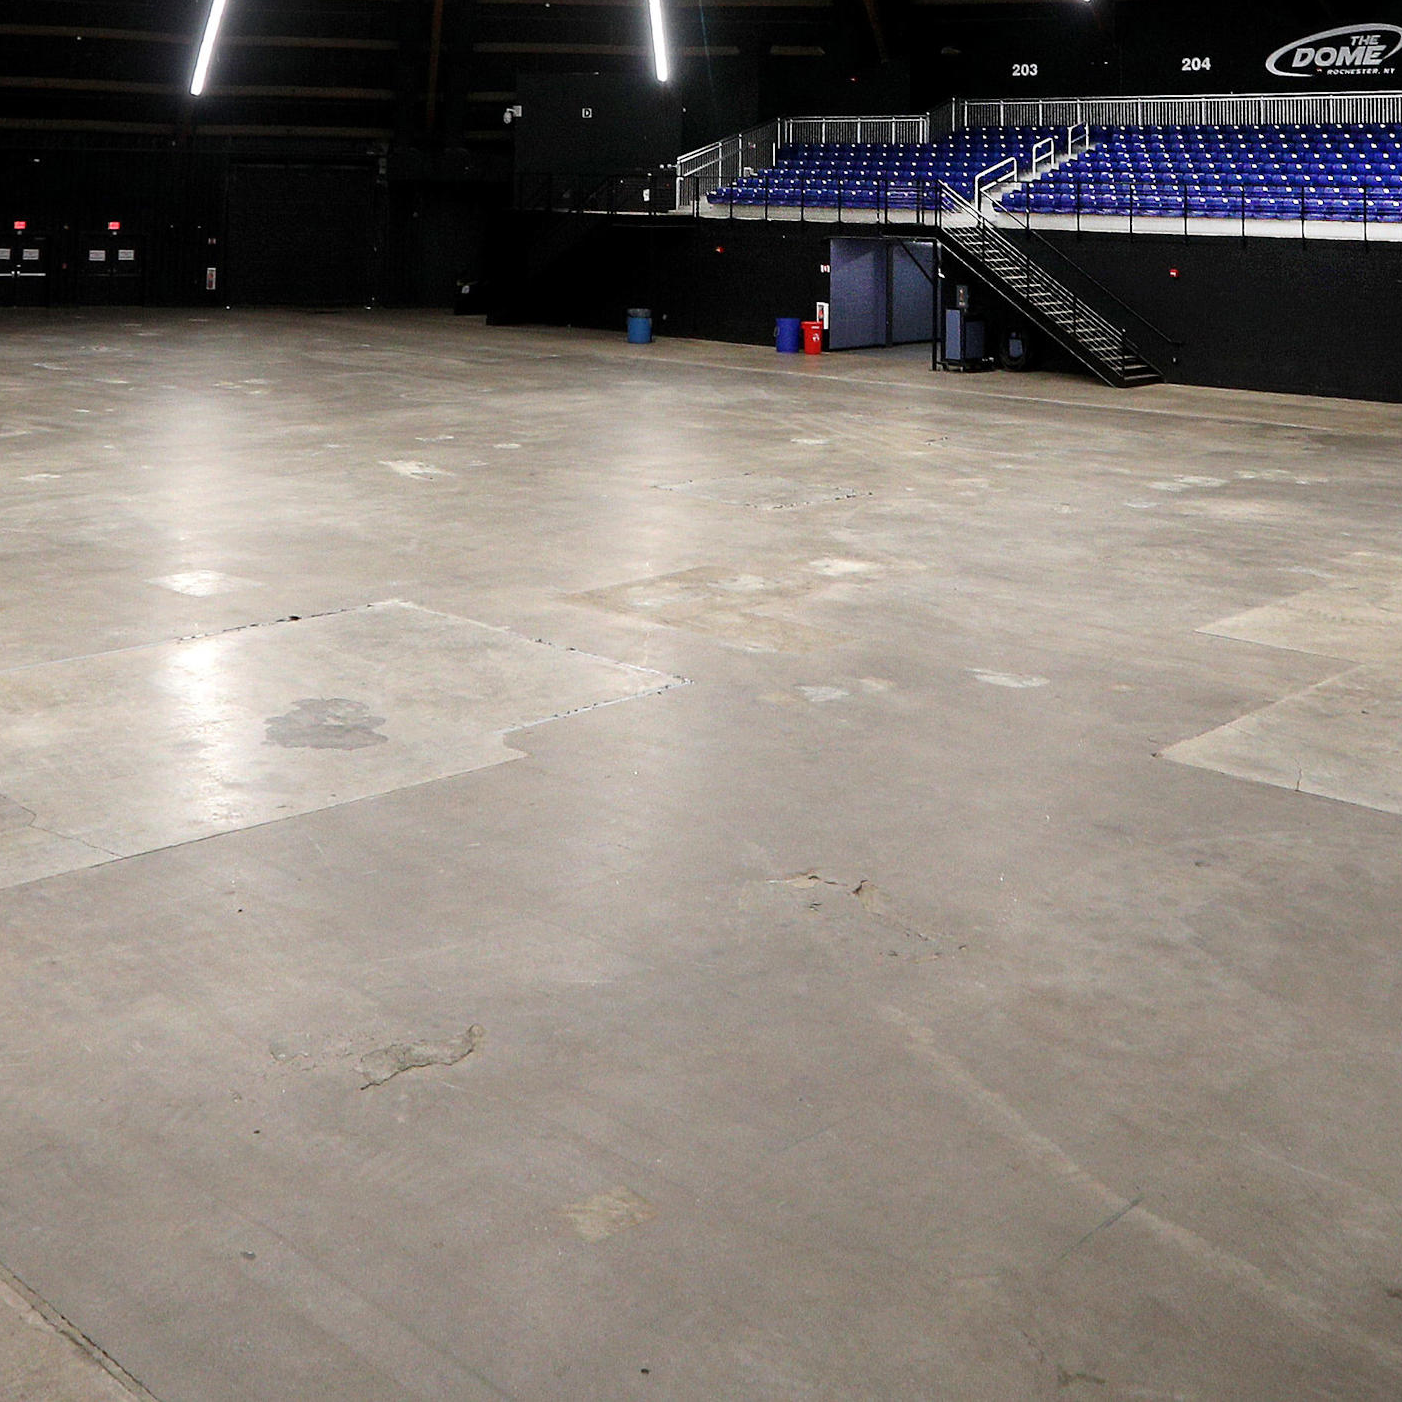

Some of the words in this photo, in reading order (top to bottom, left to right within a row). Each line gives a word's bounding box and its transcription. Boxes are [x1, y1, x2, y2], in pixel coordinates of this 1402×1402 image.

[1350, 34, 1381, 46] THE
[1291, 44, 1387, 68] DOME
[1011, 63, 1039, 77] 203
[1181, 56, 1212, 71] 204
[1383, 67, 1396, 75] NY
